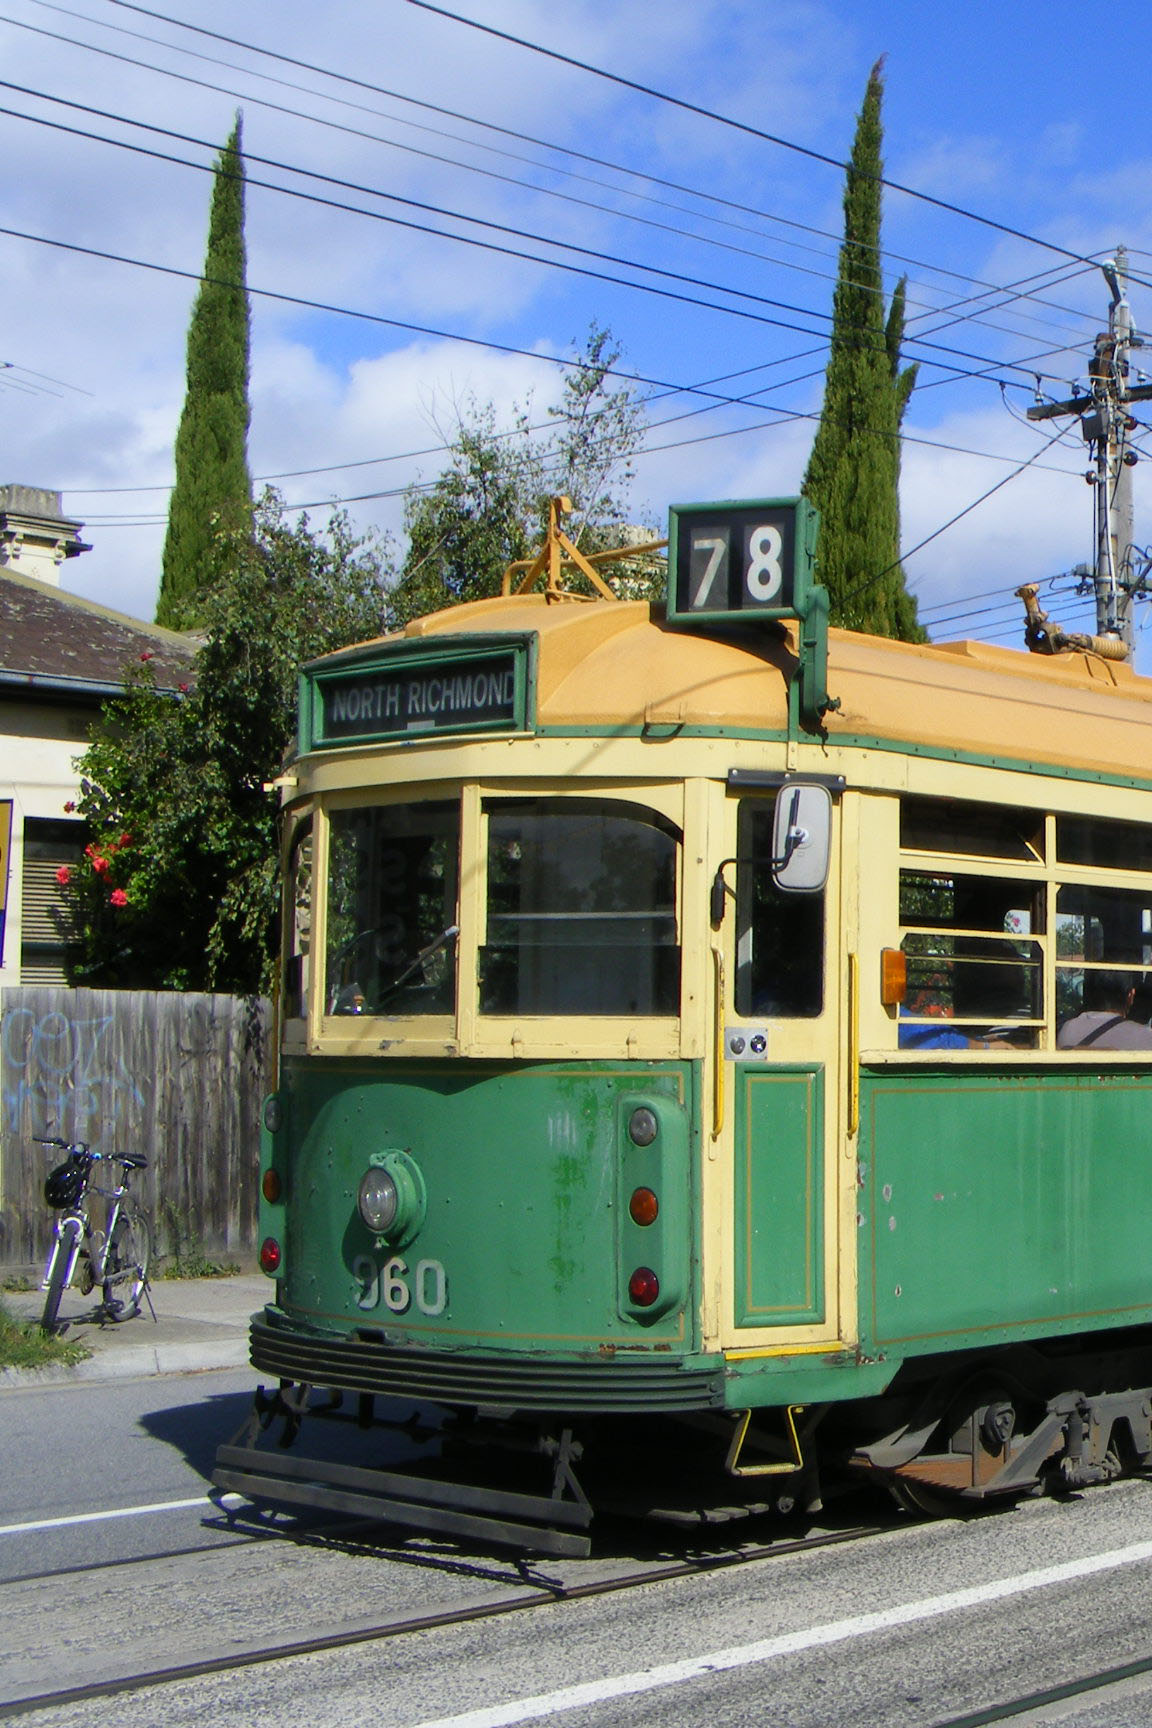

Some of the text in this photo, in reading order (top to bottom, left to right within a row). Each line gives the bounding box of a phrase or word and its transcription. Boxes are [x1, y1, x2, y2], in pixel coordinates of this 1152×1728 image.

[693, 526, 782, 608] 78
[333, 671, 515, 722] NORTH RICHMOND
[353, 1255, 446, 1316] 960
